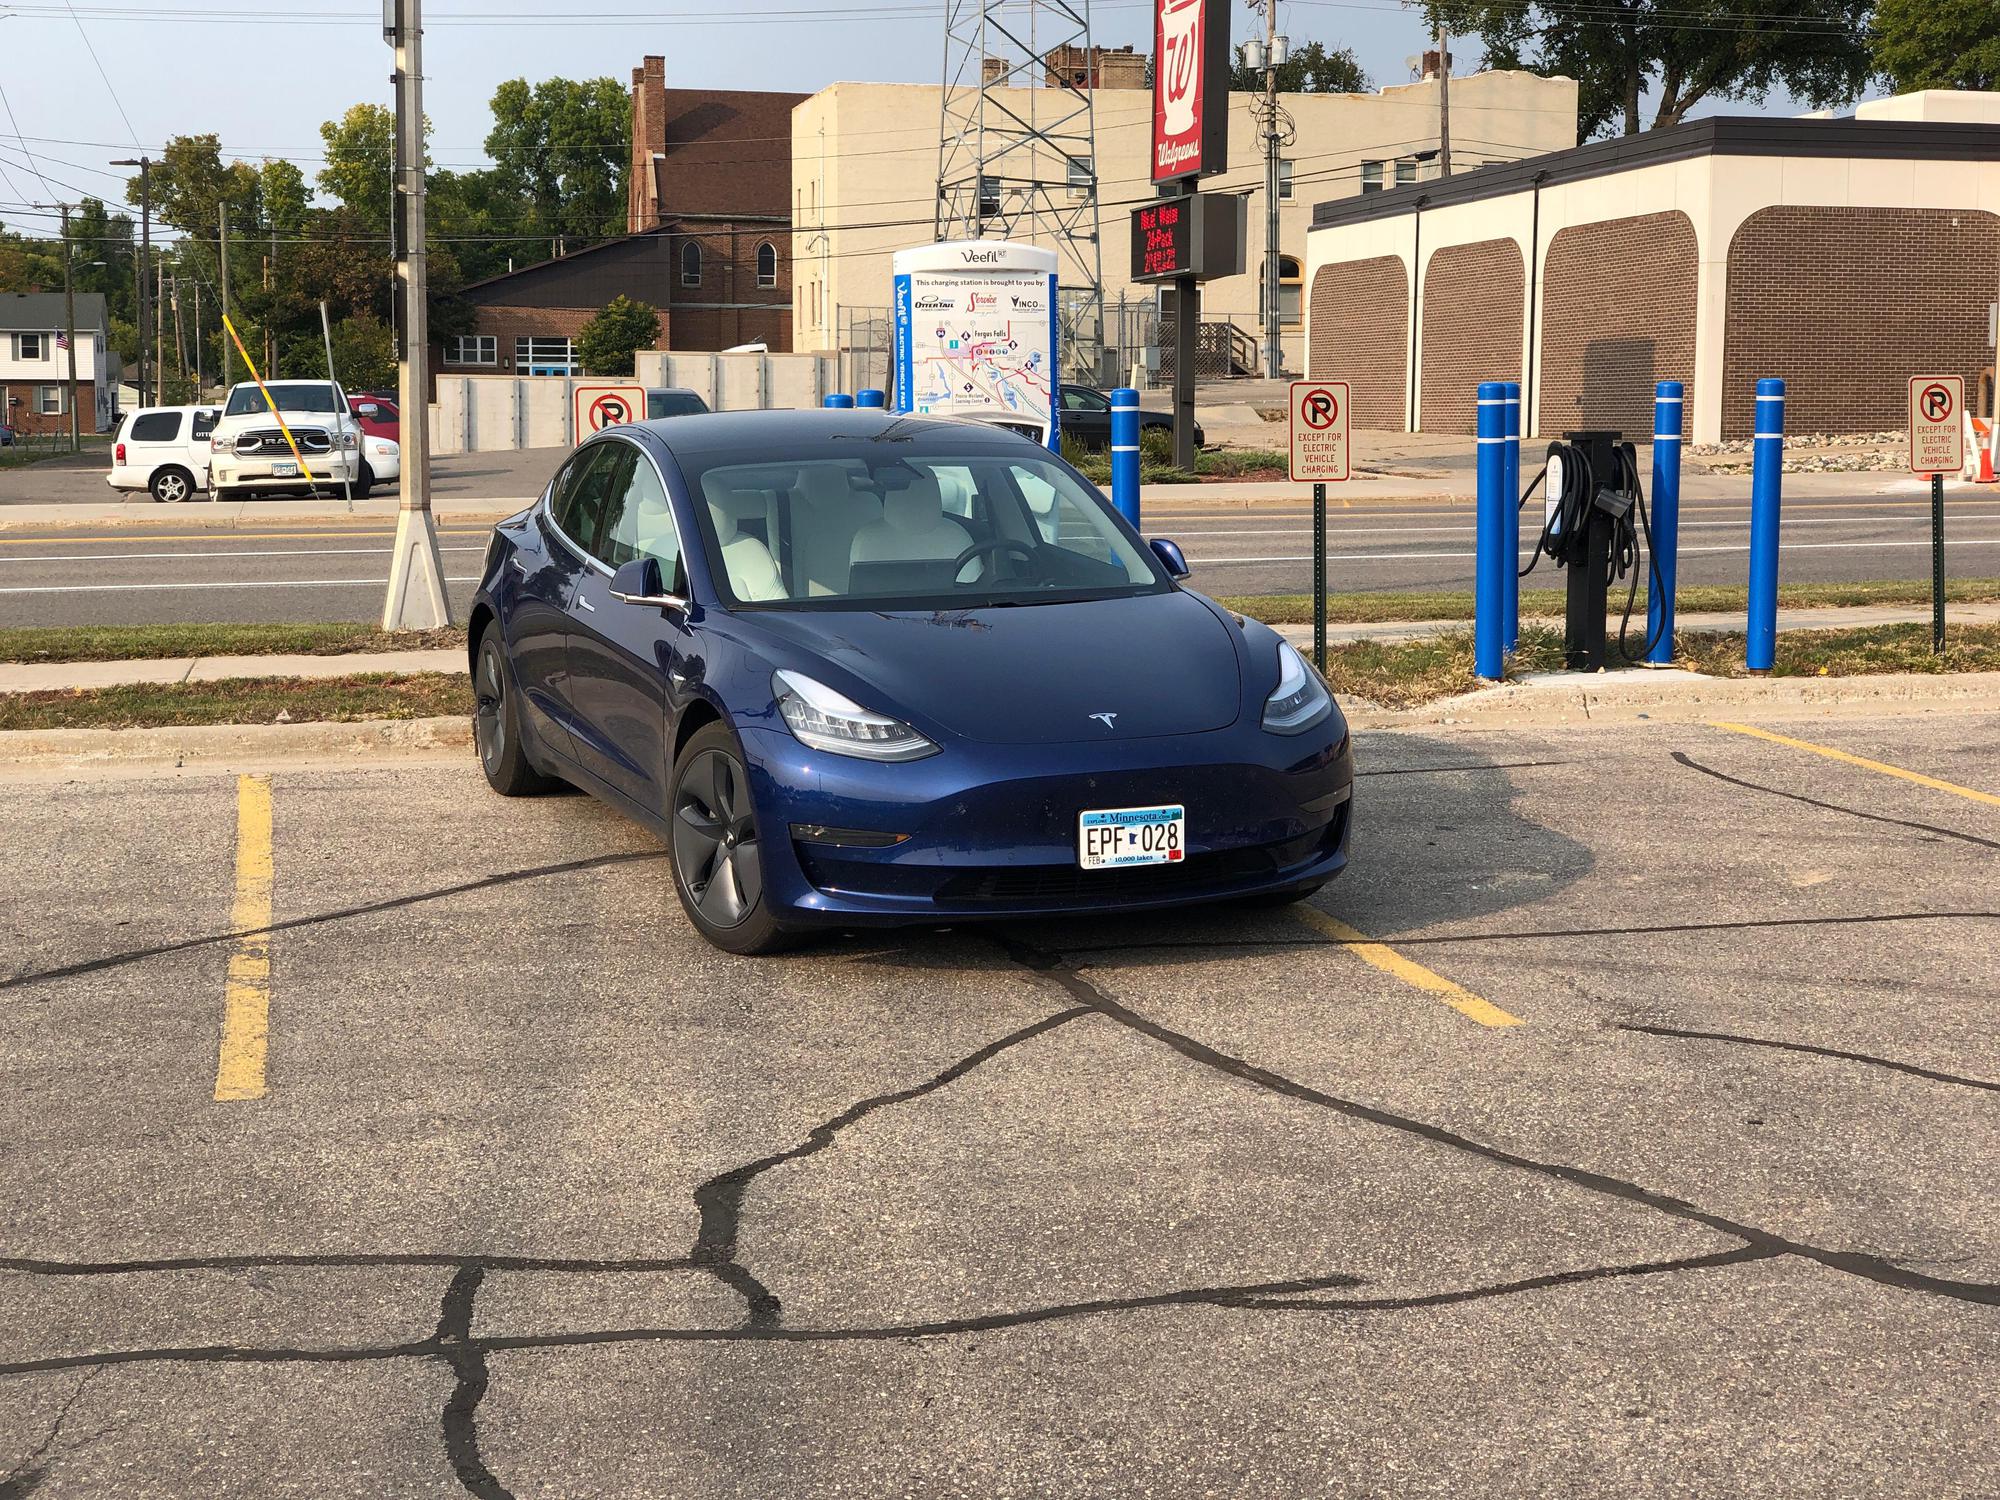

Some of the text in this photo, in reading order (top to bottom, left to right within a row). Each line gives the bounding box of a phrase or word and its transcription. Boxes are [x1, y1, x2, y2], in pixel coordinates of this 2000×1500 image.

[1157, 138, 1200, 171] Walgreens
[961, 249, 998, 263] Veefil
[897, 282, 908, 318] Veefil
[965, 292, 997, 313] Service
[975, 330, 993, 339] Fergus
[1917, 425, 1957, 434] EXCEPT FOR
[1298, 433, 1342, 441] EXCEPT FOR
[1922, 436, 1951, 444] ELECTRIC
[1303, 444, 1337, 452] ELECTRIC
[1923, 446, 1951, 454] VEHICLE
[1304, 454, 1335, 462] VEHICLE
[1920, 456, 1954, 465] CHARGING
[1301, 465, 1339, 473] CHARGING
[1087, 823, 1178, 855] EPF 028
[1088, 856, 1101, 865] FEB
